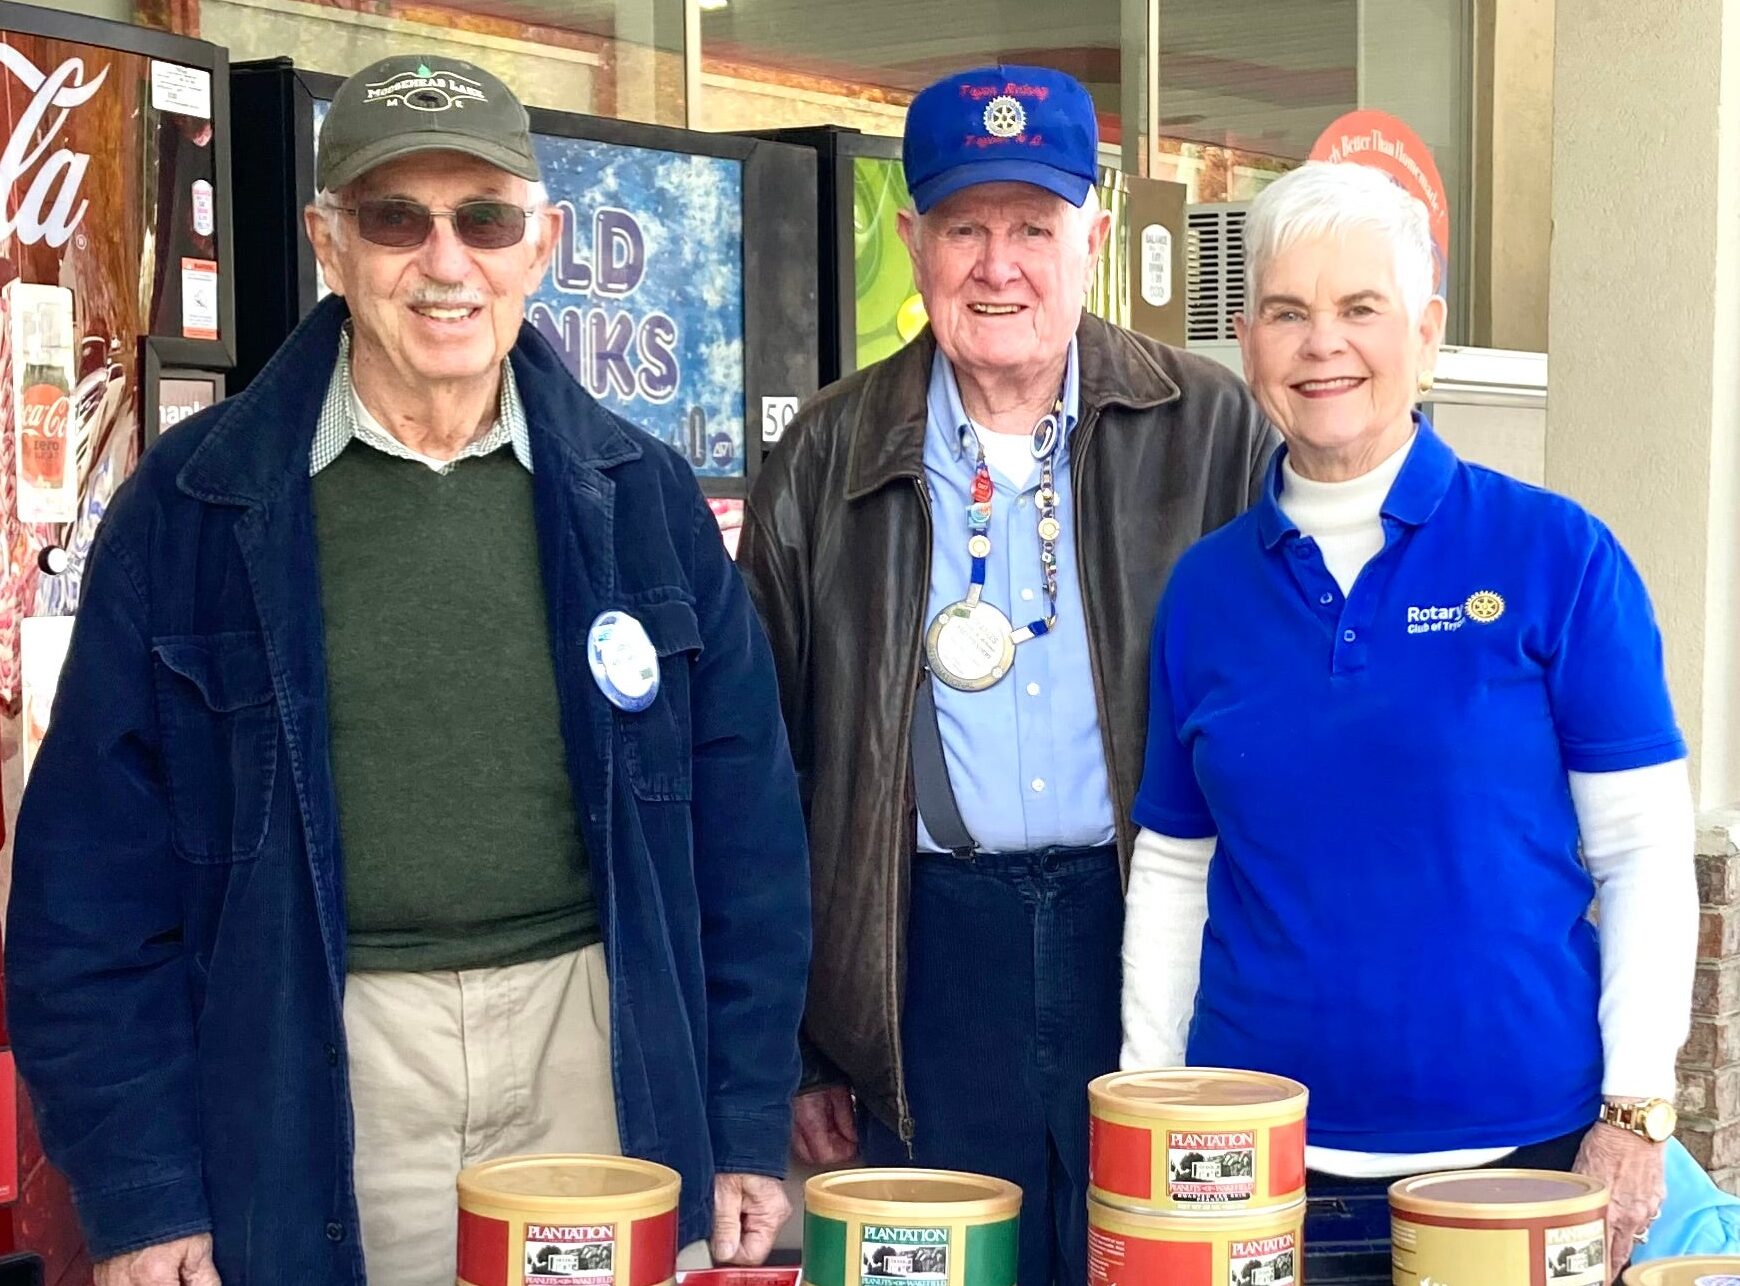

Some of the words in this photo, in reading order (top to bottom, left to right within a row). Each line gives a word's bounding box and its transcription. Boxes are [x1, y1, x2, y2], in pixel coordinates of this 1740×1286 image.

[367, 79, 446, 99] MOOSEHEAD
[448, 80, 485, 99] LAKE
[1341, 135, 1371, 158] Better
[1371, 129, 1395, 157] Than
[1407, 604, 1463, 622] Rotary
[1407, 622, 1429, 634] Club
[1431, 621, 1442, 631] of
[1171, 1133, 1253, 1147] PLANTATION
[528, 1225, 613, 1240] PLANTATION
[864, 1226, 947, 1242] PLANTATION
[1232, 1233, 1294, 1255] PLANTATION
